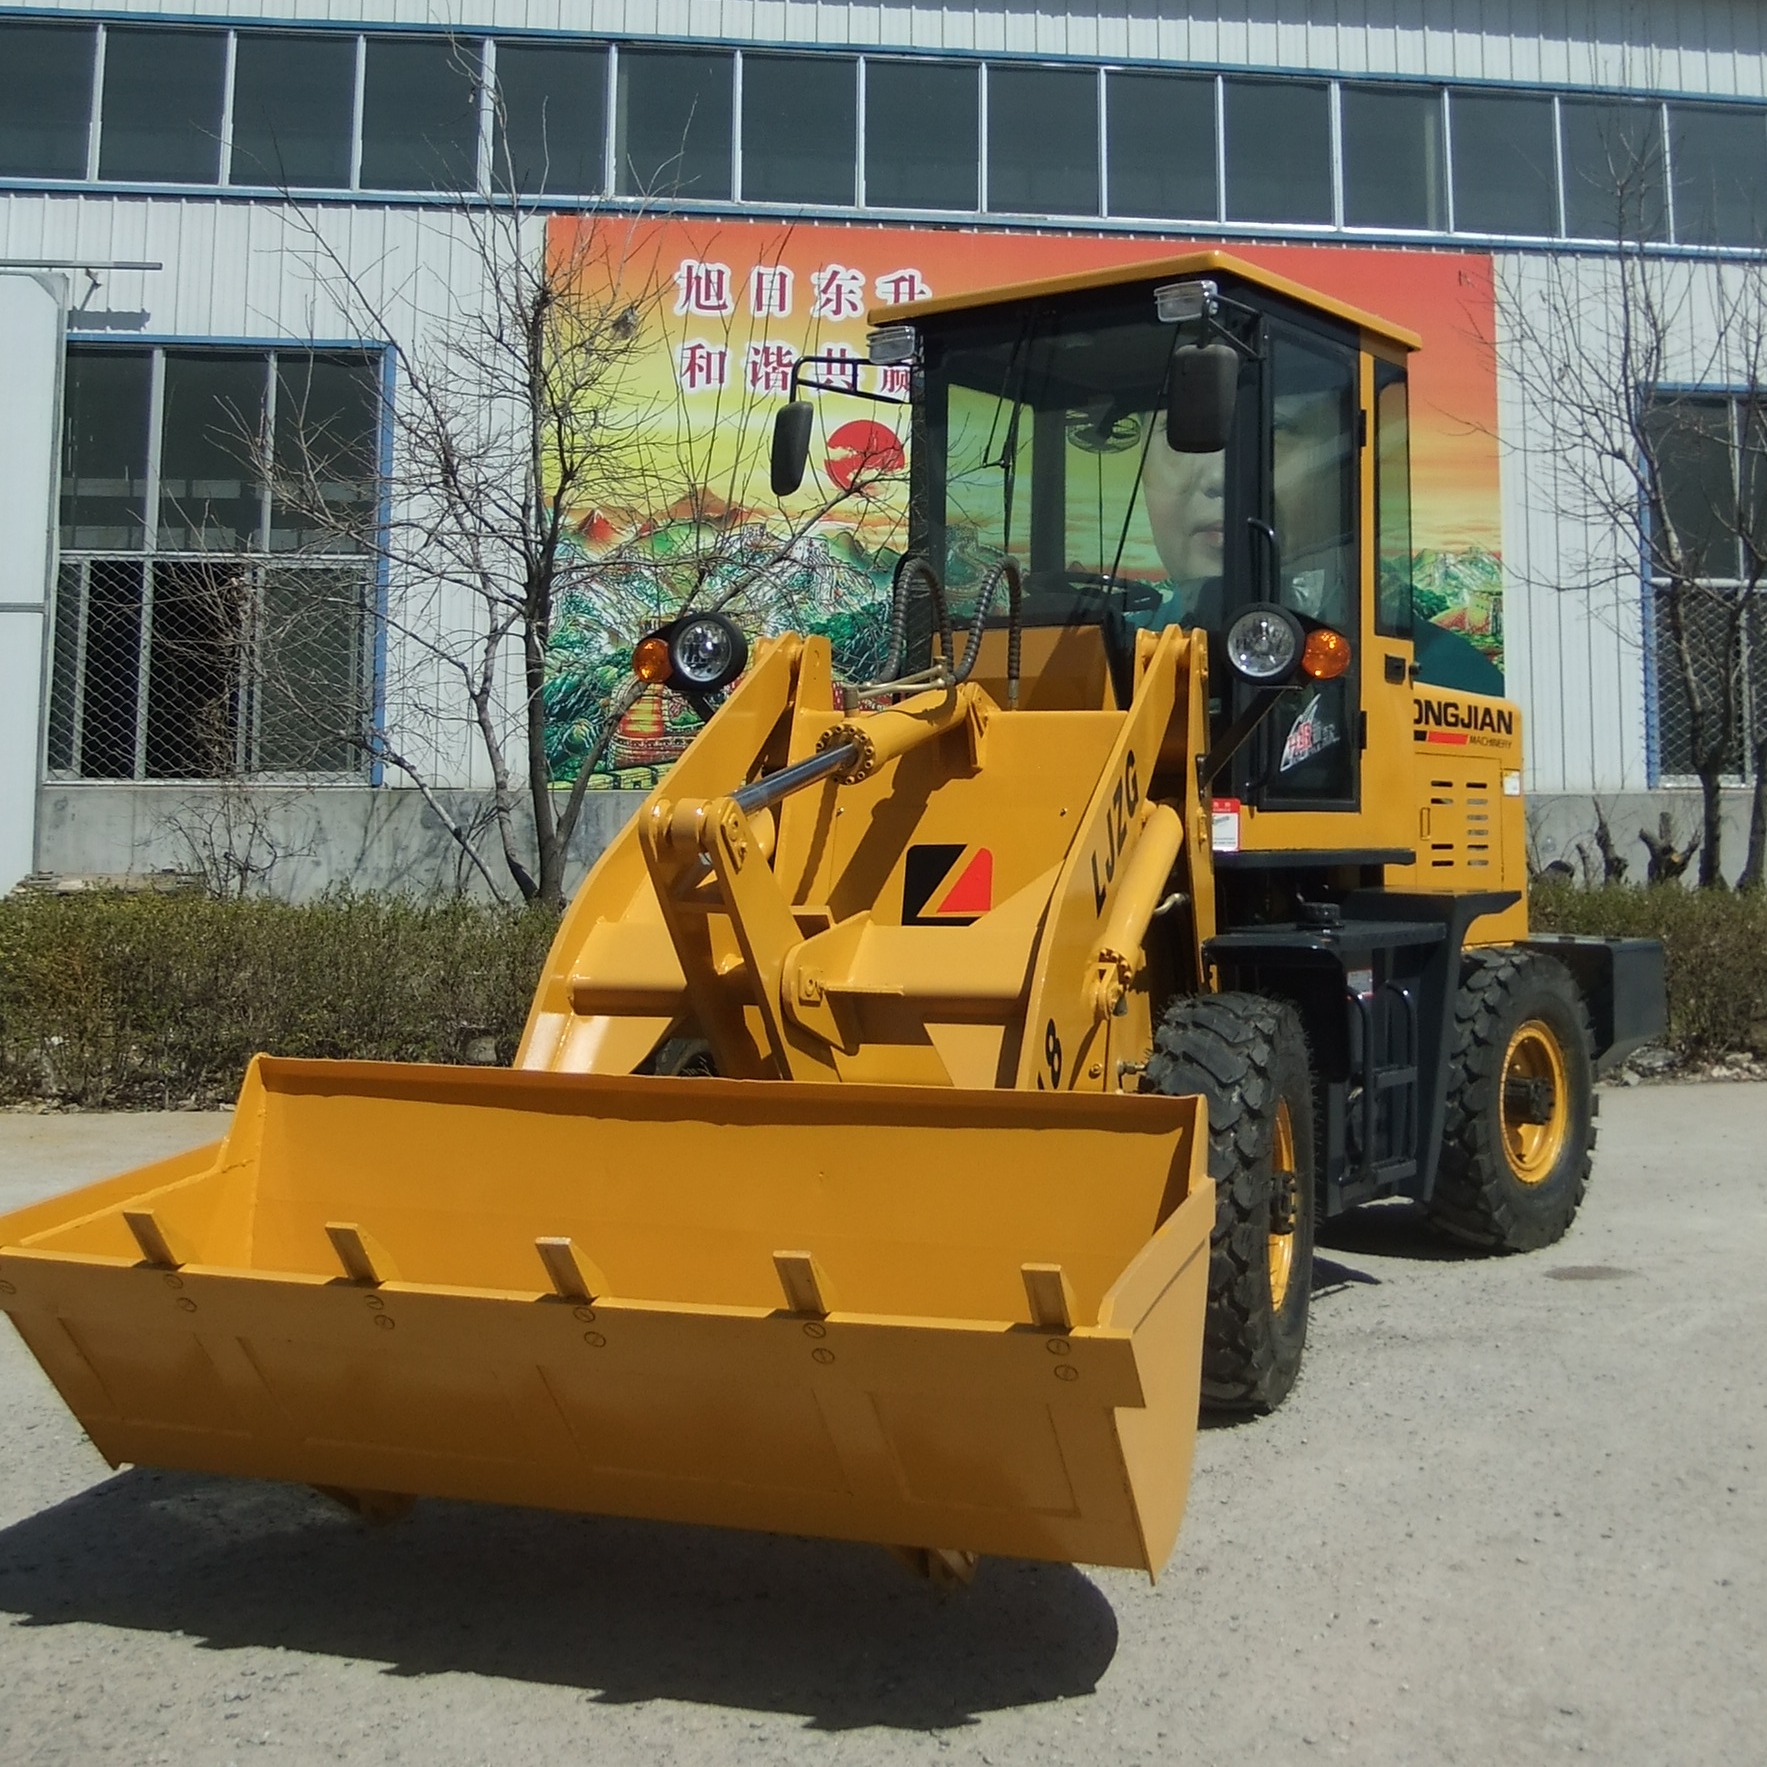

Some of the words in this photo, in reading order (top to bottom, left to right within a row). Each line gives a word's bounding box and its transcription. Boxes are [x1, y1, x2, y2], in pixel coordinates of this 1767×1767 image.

[677, 262, 929, 319] 旭日东升
[1470, 735, 1513, 749] MACHINERY
[1089, 749, 1140, 919] LJZG
